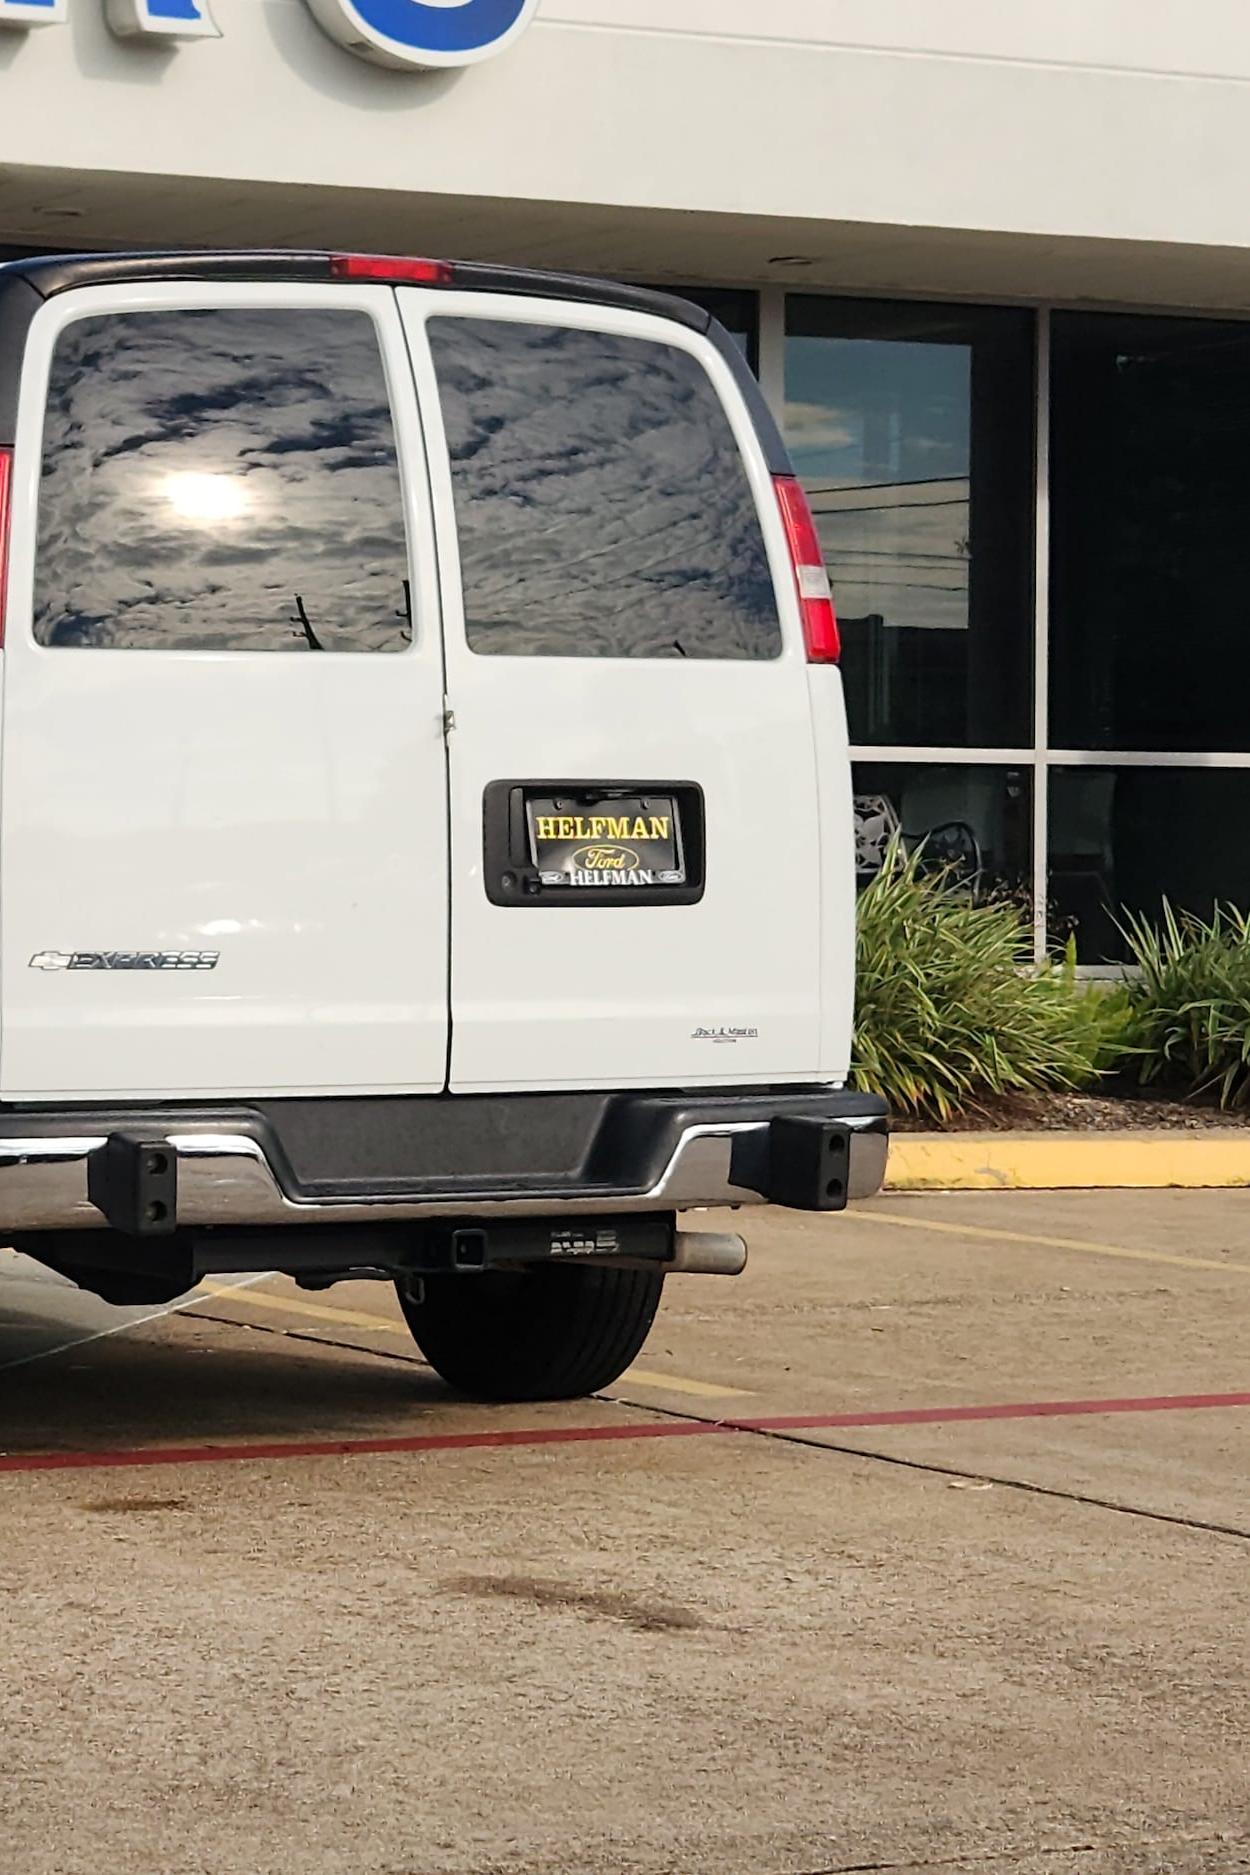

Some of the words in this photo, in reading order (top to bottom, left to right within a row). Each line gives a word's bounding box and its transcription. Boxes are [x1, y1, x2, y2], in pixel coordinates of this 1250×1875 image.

[536, 816, 669, 839] HELFMAN
[584, 849, 626, 869] Ford
[570, 868, 653, 886] HELFMAN
[68, 951, 220, 969] EXPRESS
